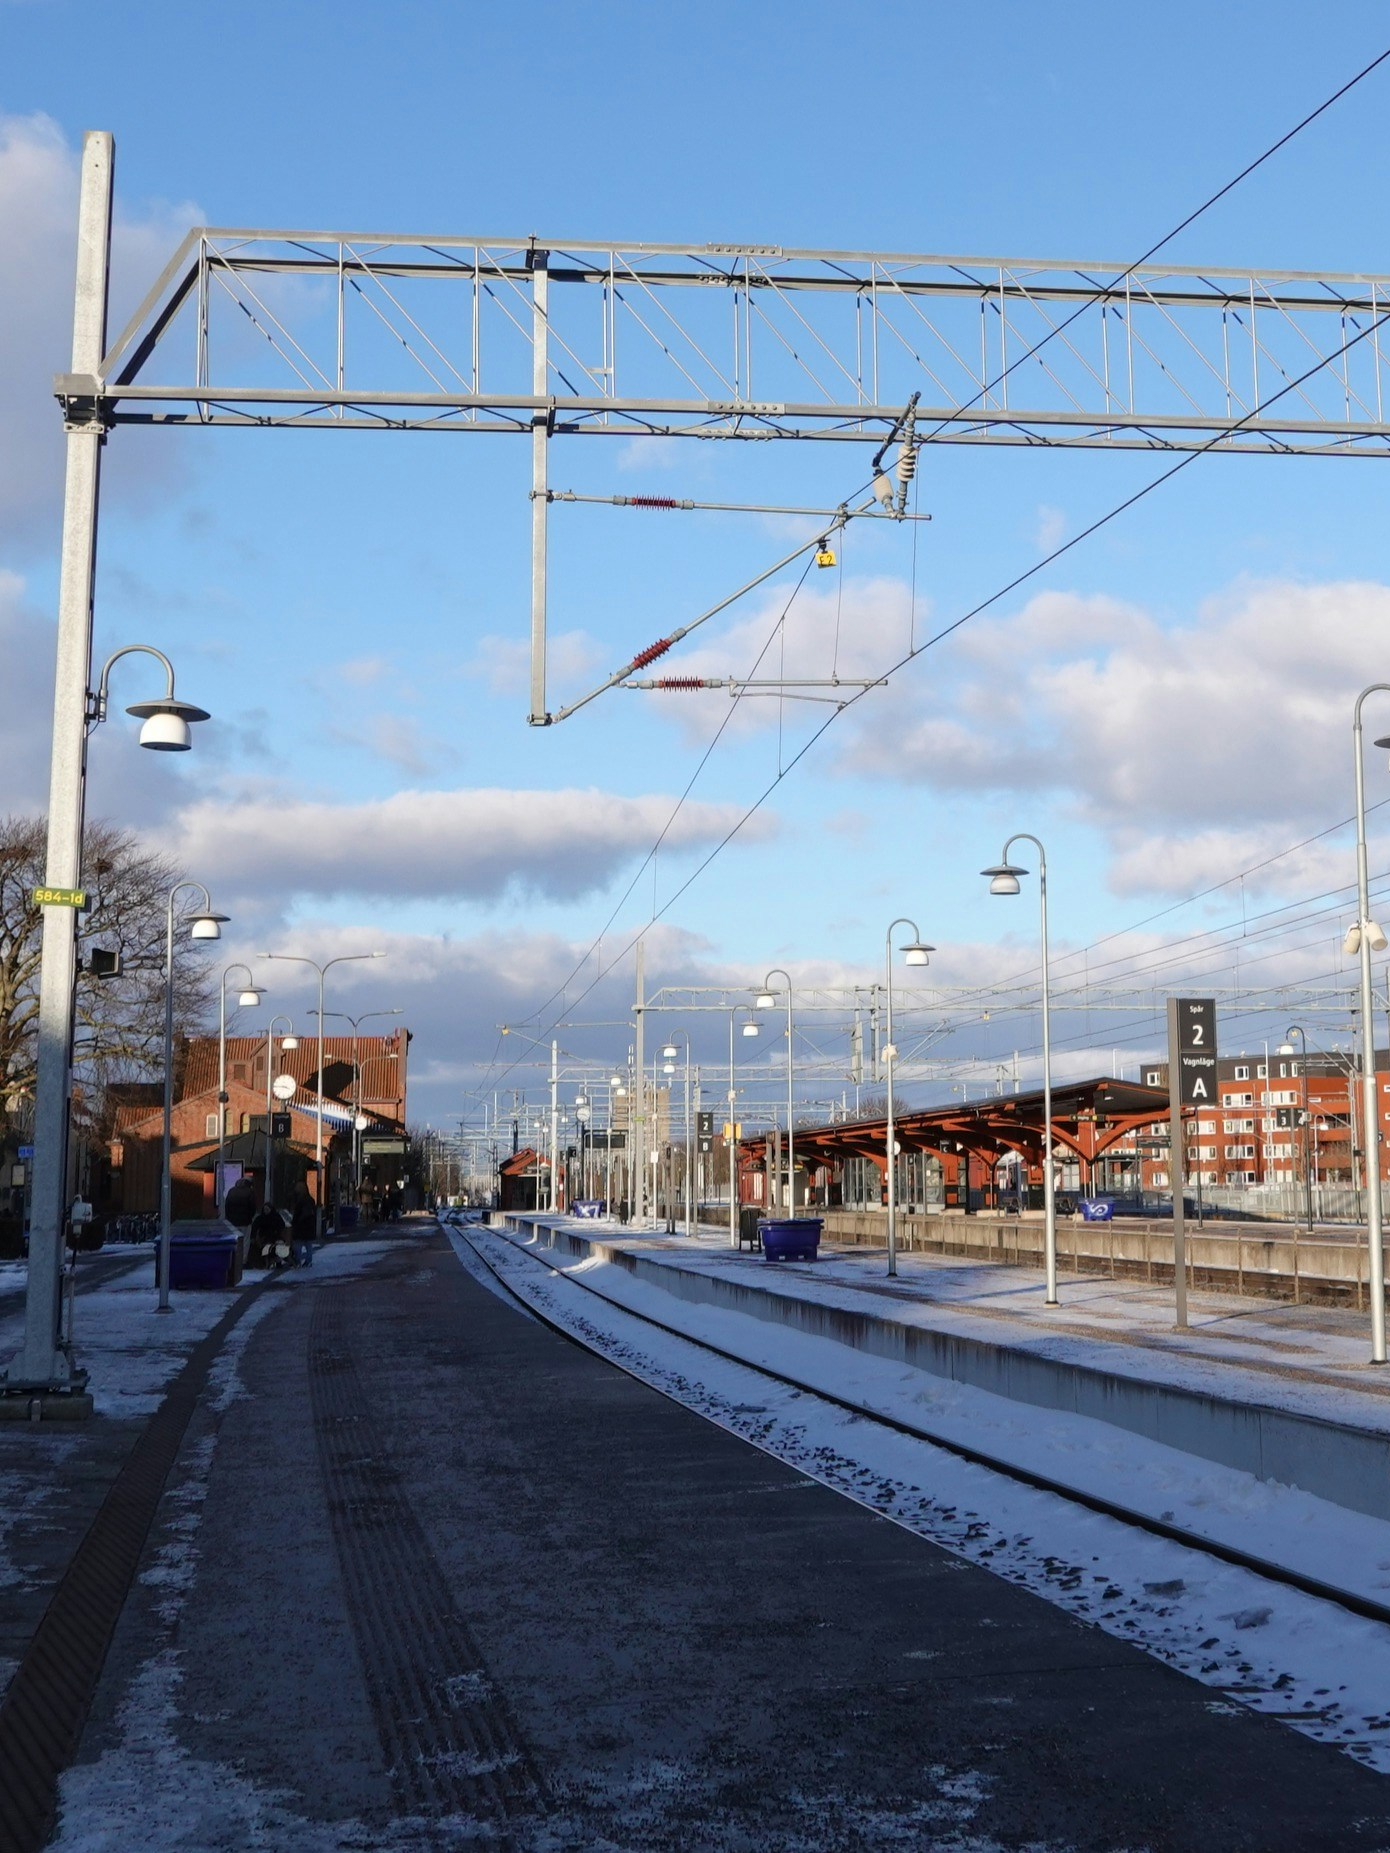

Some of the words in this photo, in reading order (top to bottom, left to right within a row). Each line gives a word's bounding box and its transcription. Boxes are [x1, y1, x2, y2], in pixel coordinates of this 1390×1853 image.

[35, 890, 83, 904] 584-1d
[1189, 1005, 1204, 1014] Spår
[1192, 1024, 1204, 1045] 2
[1182, 1057, 1215, 1068] Vagnläge
[1192, 1077, 1208, 1098] A
[278, 1123, 284, 1133] B
[702, 1121, 709, 1131] 2
